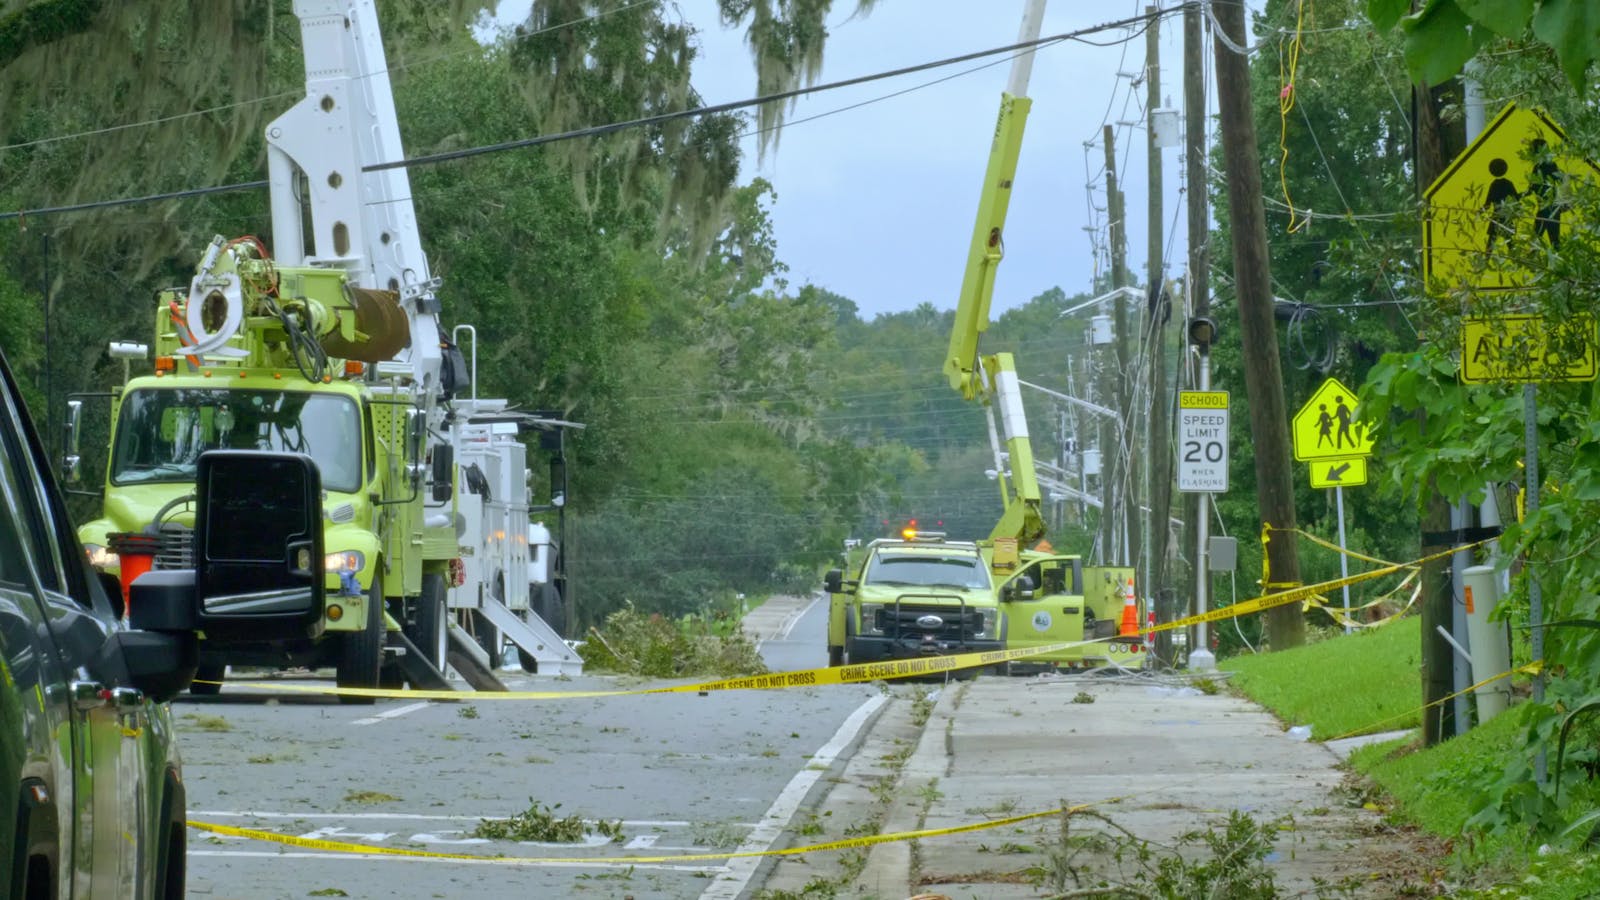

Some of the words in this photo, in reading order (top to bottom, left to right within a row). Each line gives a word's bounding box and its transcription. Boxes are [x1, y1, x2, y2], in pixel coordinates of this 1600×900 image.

[1182, 395, 1225, 406] SCHOOL
[1183, 415, 1225, 425] SPEED
[1187, 428, 1220, 438] LIMIT
[1184, 441, 1223, 463] 20
[840, 666, 867, 681] CRIME
[869, 663, 896, 677] SCENE
[897, 662, 909, 674] DO
[910, 660, 927, 673] NOT
[928, 657, 957, 670] CROSS
[728, 679, 756, 689] SCENE
[757, 677, 769, 688] DO
[770, 675, 786, 687] NOT
[787, 672, 816, 686] CROSS
